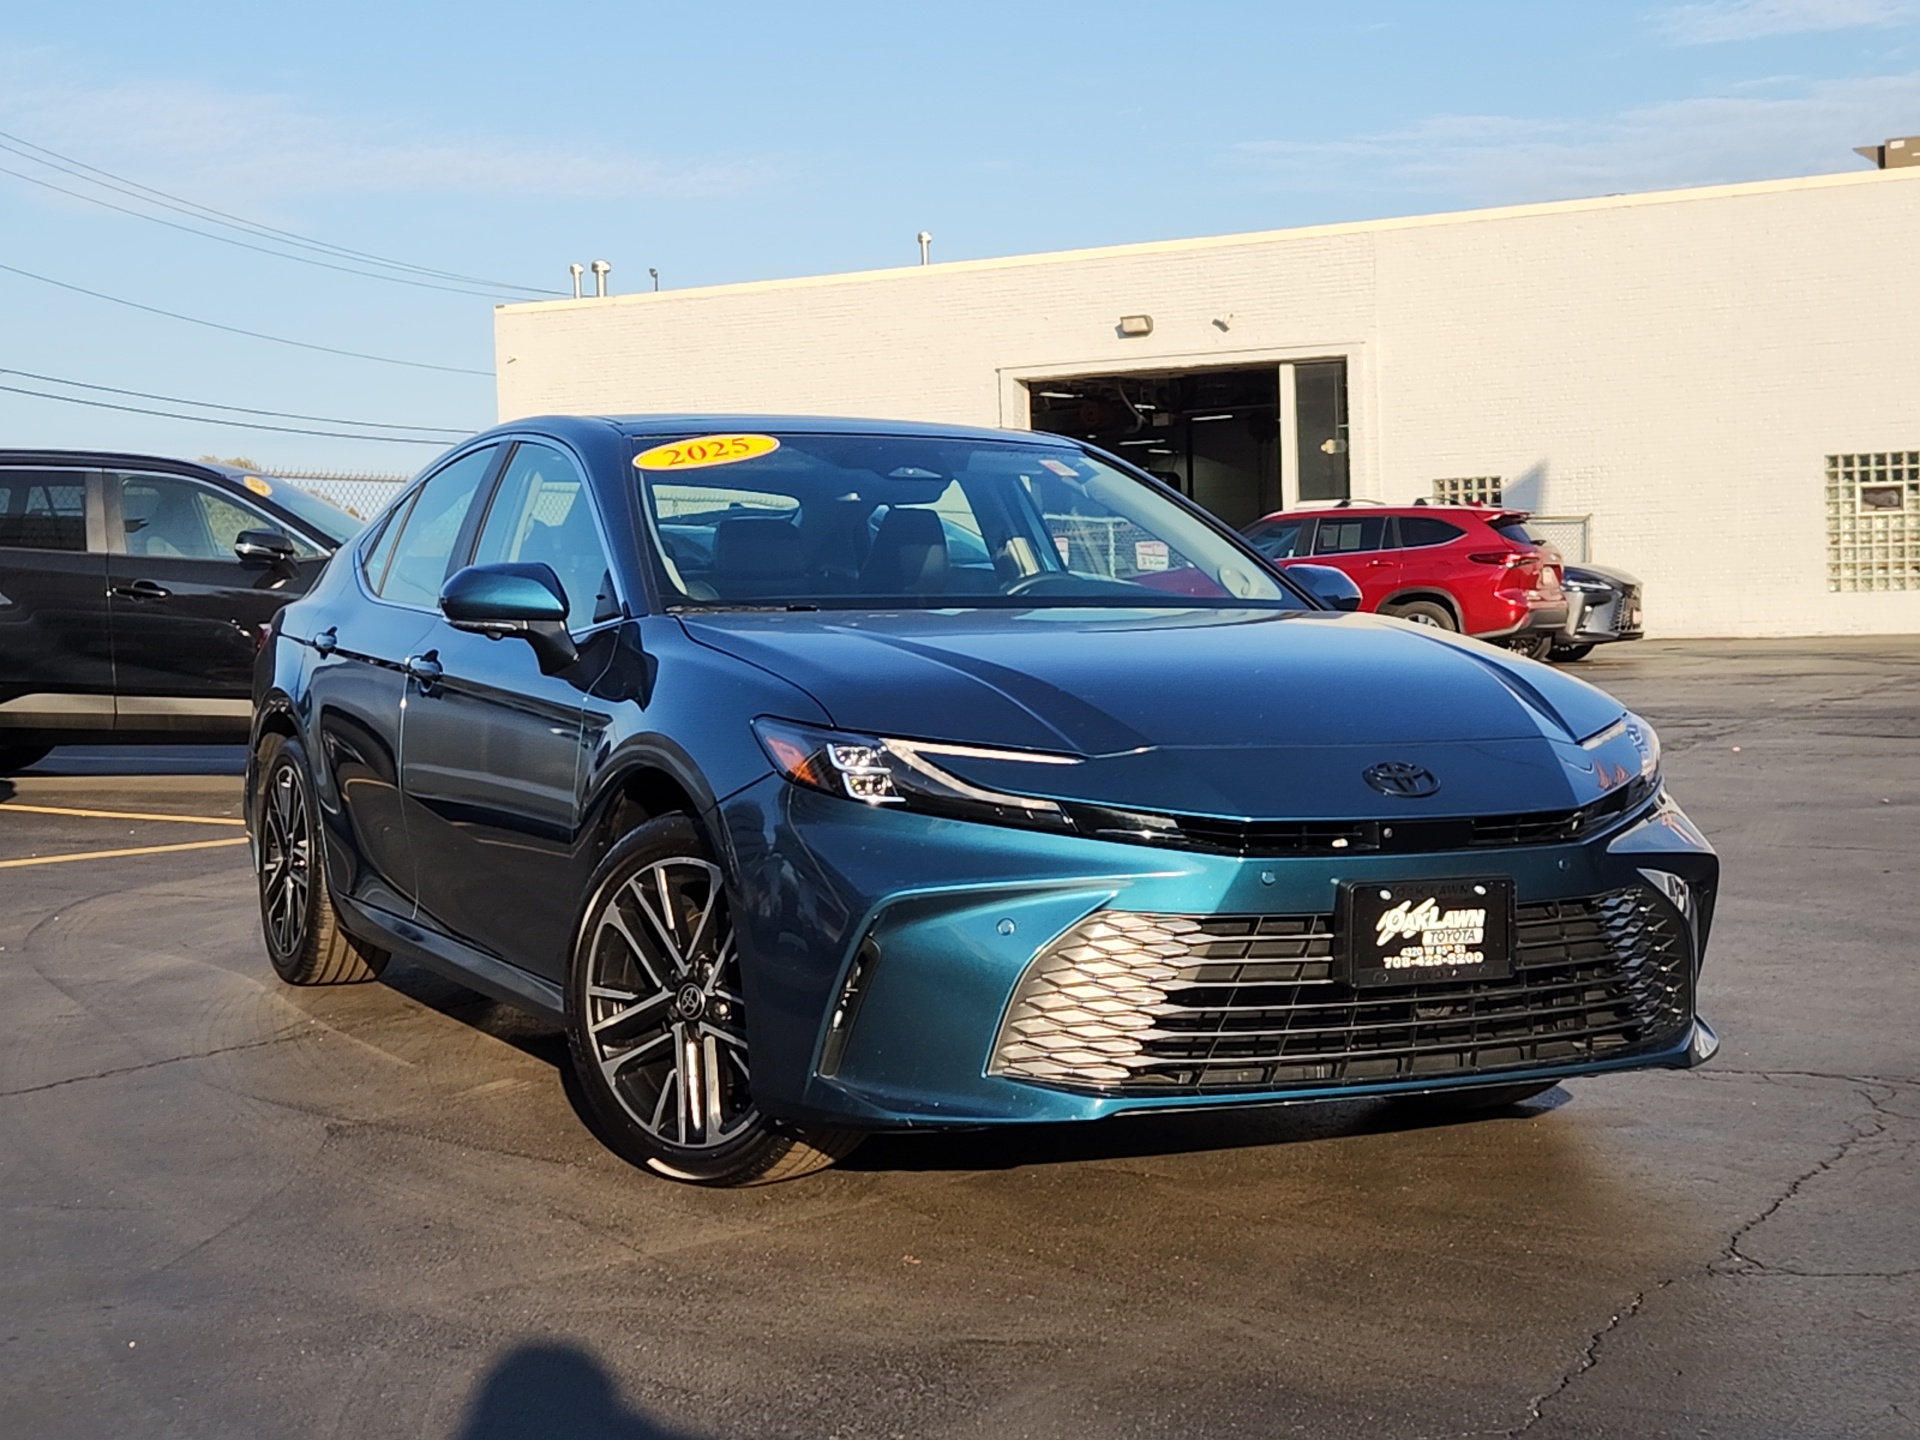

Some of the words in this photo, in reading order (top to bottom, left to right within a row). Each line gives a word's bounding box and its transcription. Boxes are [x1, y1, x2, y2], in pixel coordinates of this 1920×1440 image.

[662, 437, 750, 466] 2025
[1430, 929, 1476, 943] TOYOTA
[1424, 945, 1435, 955] W
[1383, 951, 1484, 969] 708-423-5200
